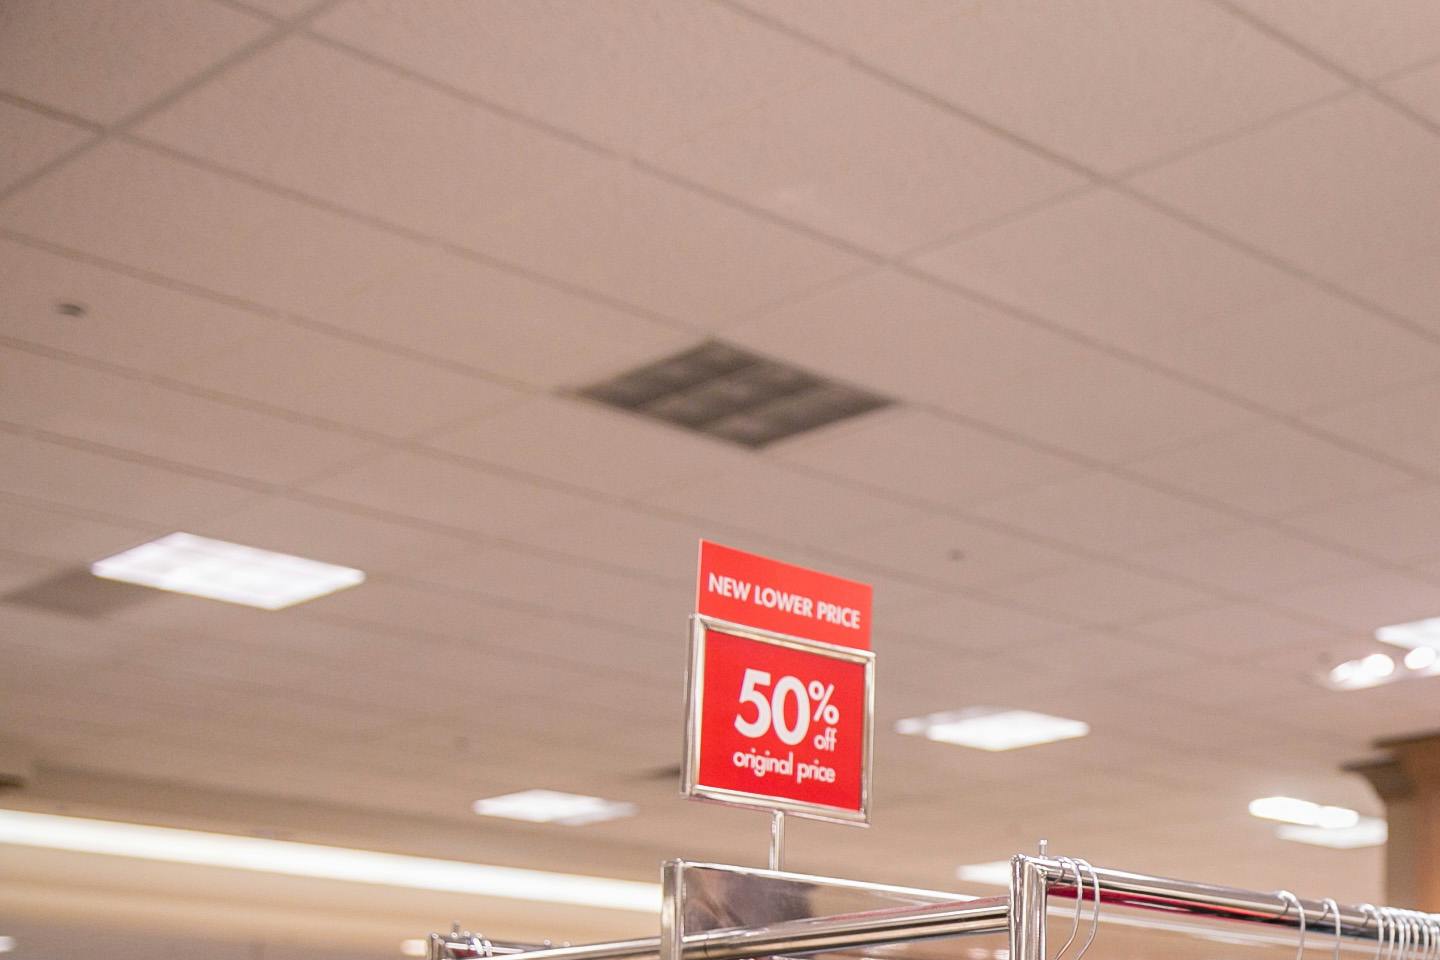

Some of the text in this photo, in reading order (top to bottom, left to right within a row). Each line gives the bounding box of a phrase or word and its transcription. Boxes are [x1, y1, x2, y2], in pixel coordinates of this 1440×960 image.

[708, 572, 861, 629] NEW LOWER PRICE
[734, 668, 840, 752] 50% off
[732, 747, 836, 784] original price
